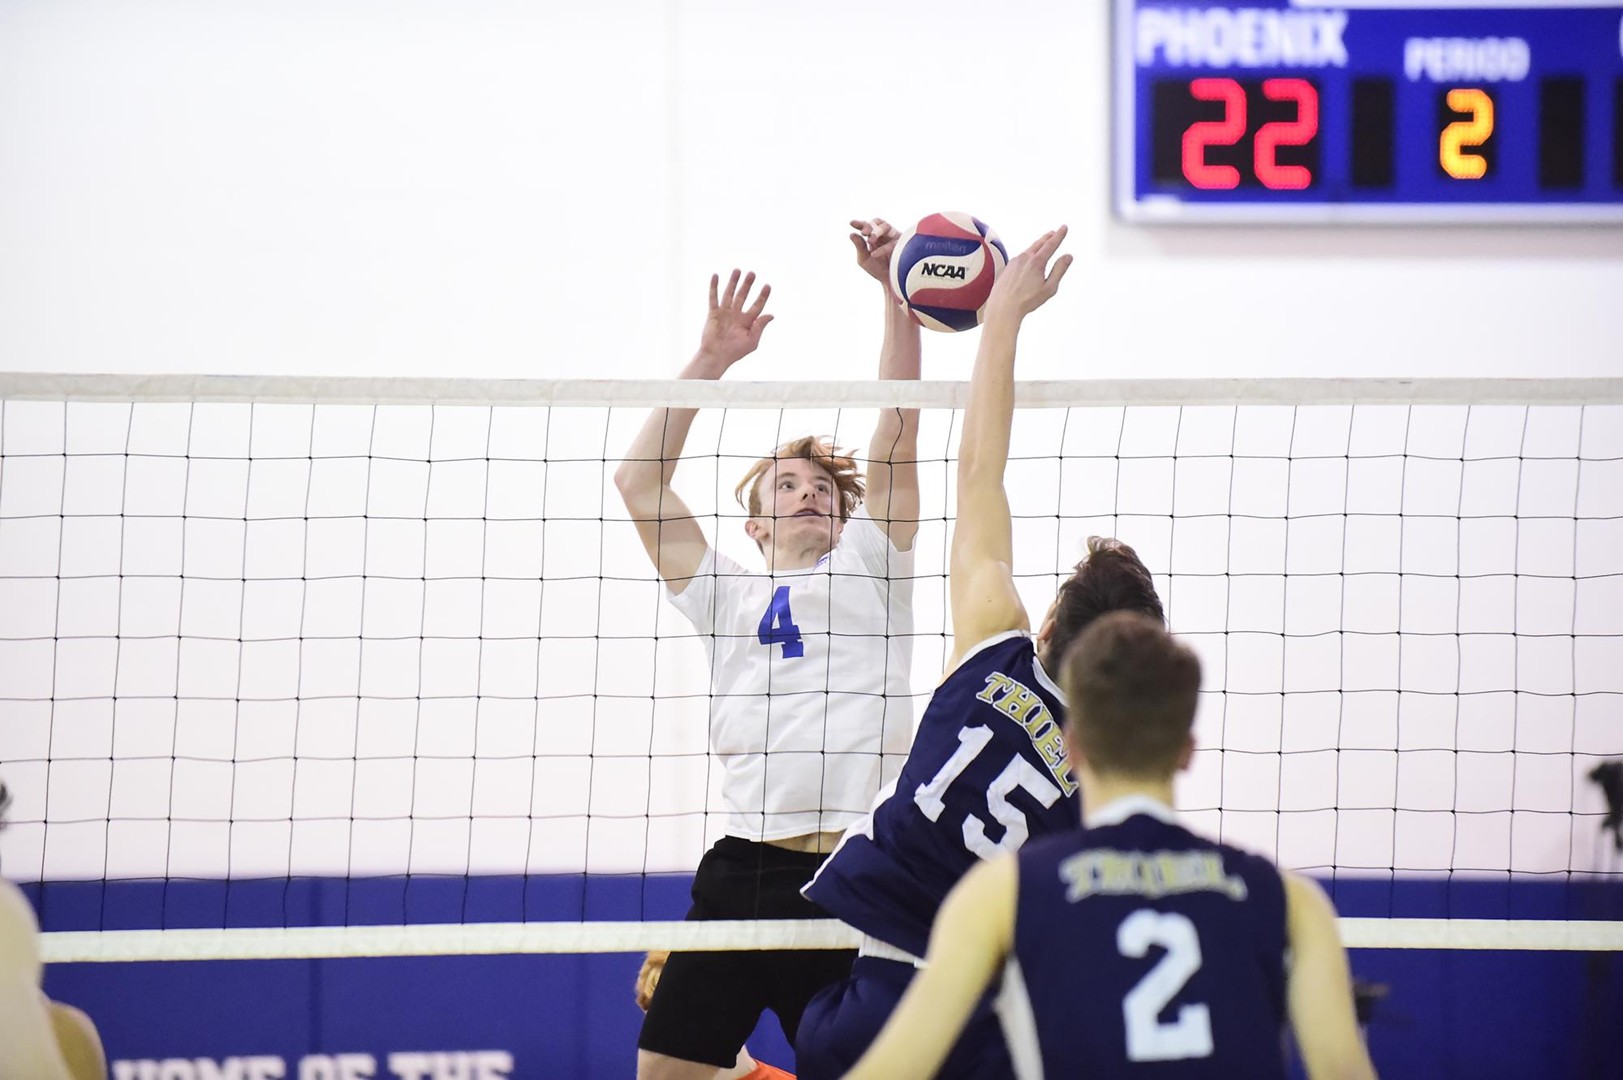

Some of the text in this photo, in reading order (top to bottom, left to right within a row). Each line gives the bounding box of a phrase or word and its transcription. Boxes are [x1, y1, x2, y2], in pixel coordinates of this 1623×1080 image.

[1136, 7, 1348, 68] PHOENIX
[1404, 36, 1530, 82] PERIOD
[1182, 78, 1319, 190] 22
[1440, 88, 1494, 180] 2
[921, 262, 966, 280] NCAA
[925, 241, 966, 254] molten
[757, 585, 804, 659] 4
[976, 671, 1079, 798] THIEL
[914, 724, 1062, 863] 15
[1116, 907, 1214, 1062] 2
